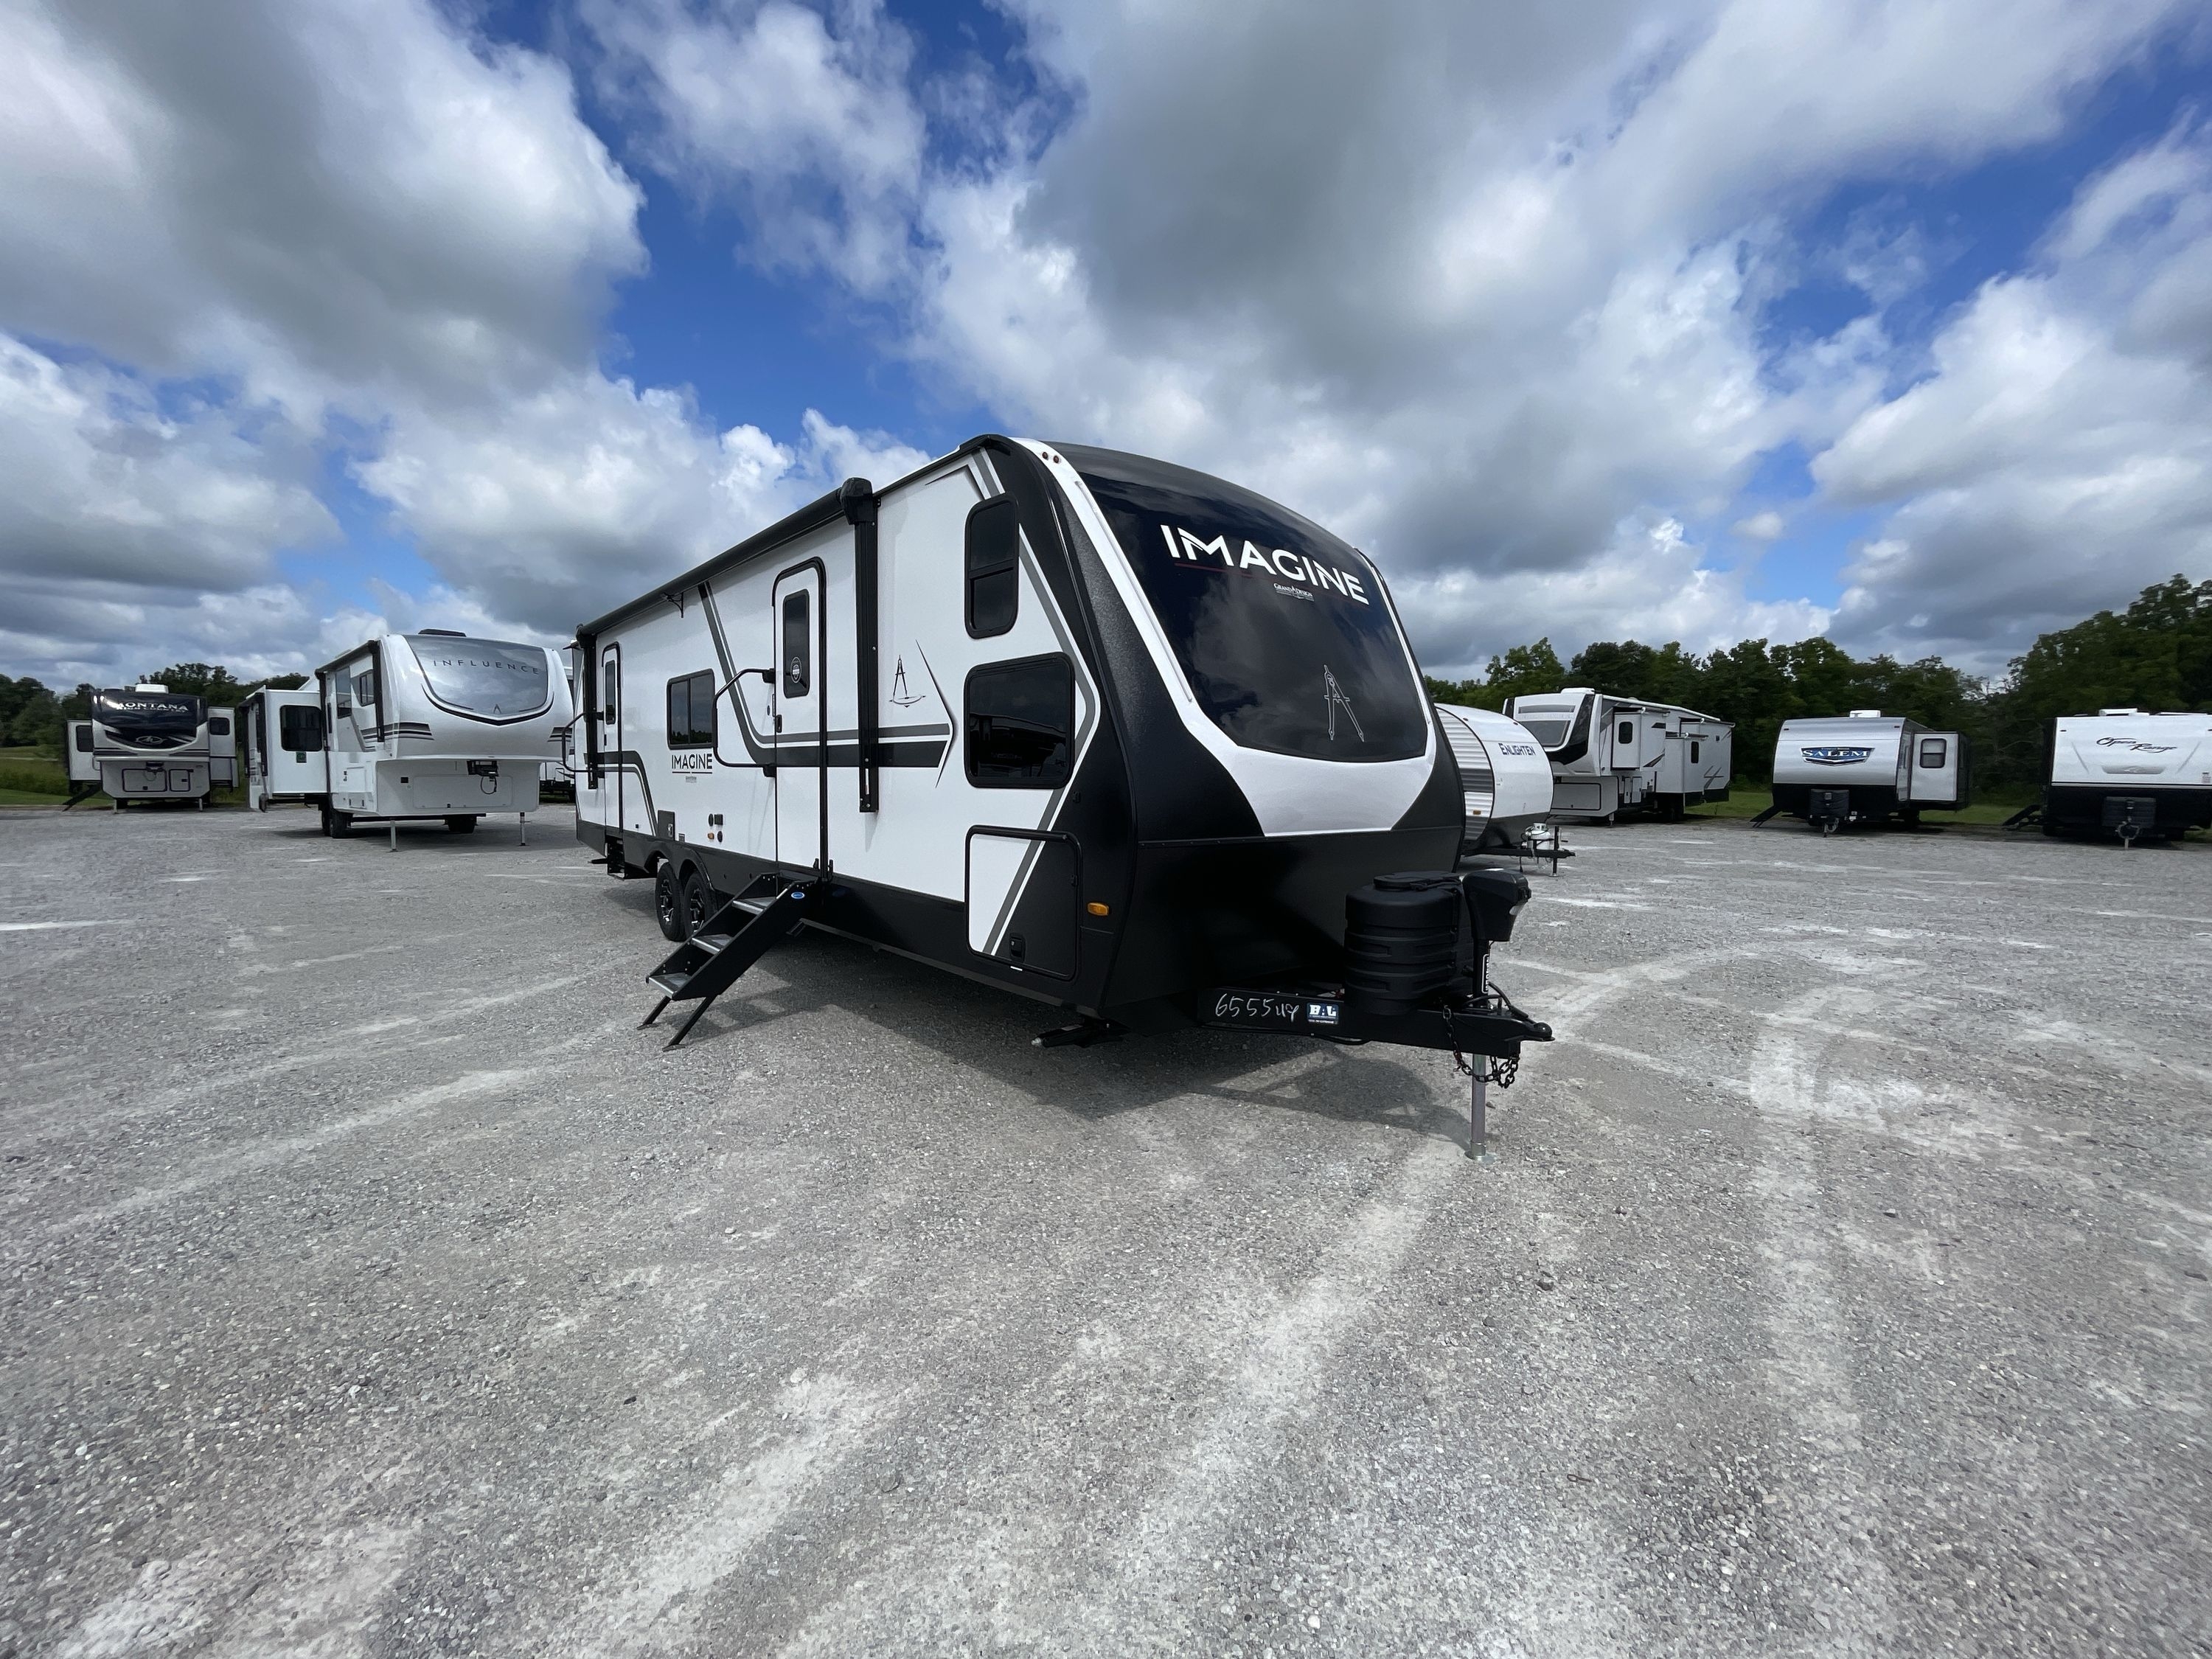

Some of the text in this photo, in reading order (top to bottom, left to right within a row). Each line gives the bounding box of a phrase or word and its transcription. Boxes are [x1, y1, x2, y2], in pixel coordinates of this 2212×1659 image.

[1160, 524, 1369, 605] IMAGINE
[434, 660, 539, 675] INFLUENCE
[672, 753, 712, 770] IMAGINE
